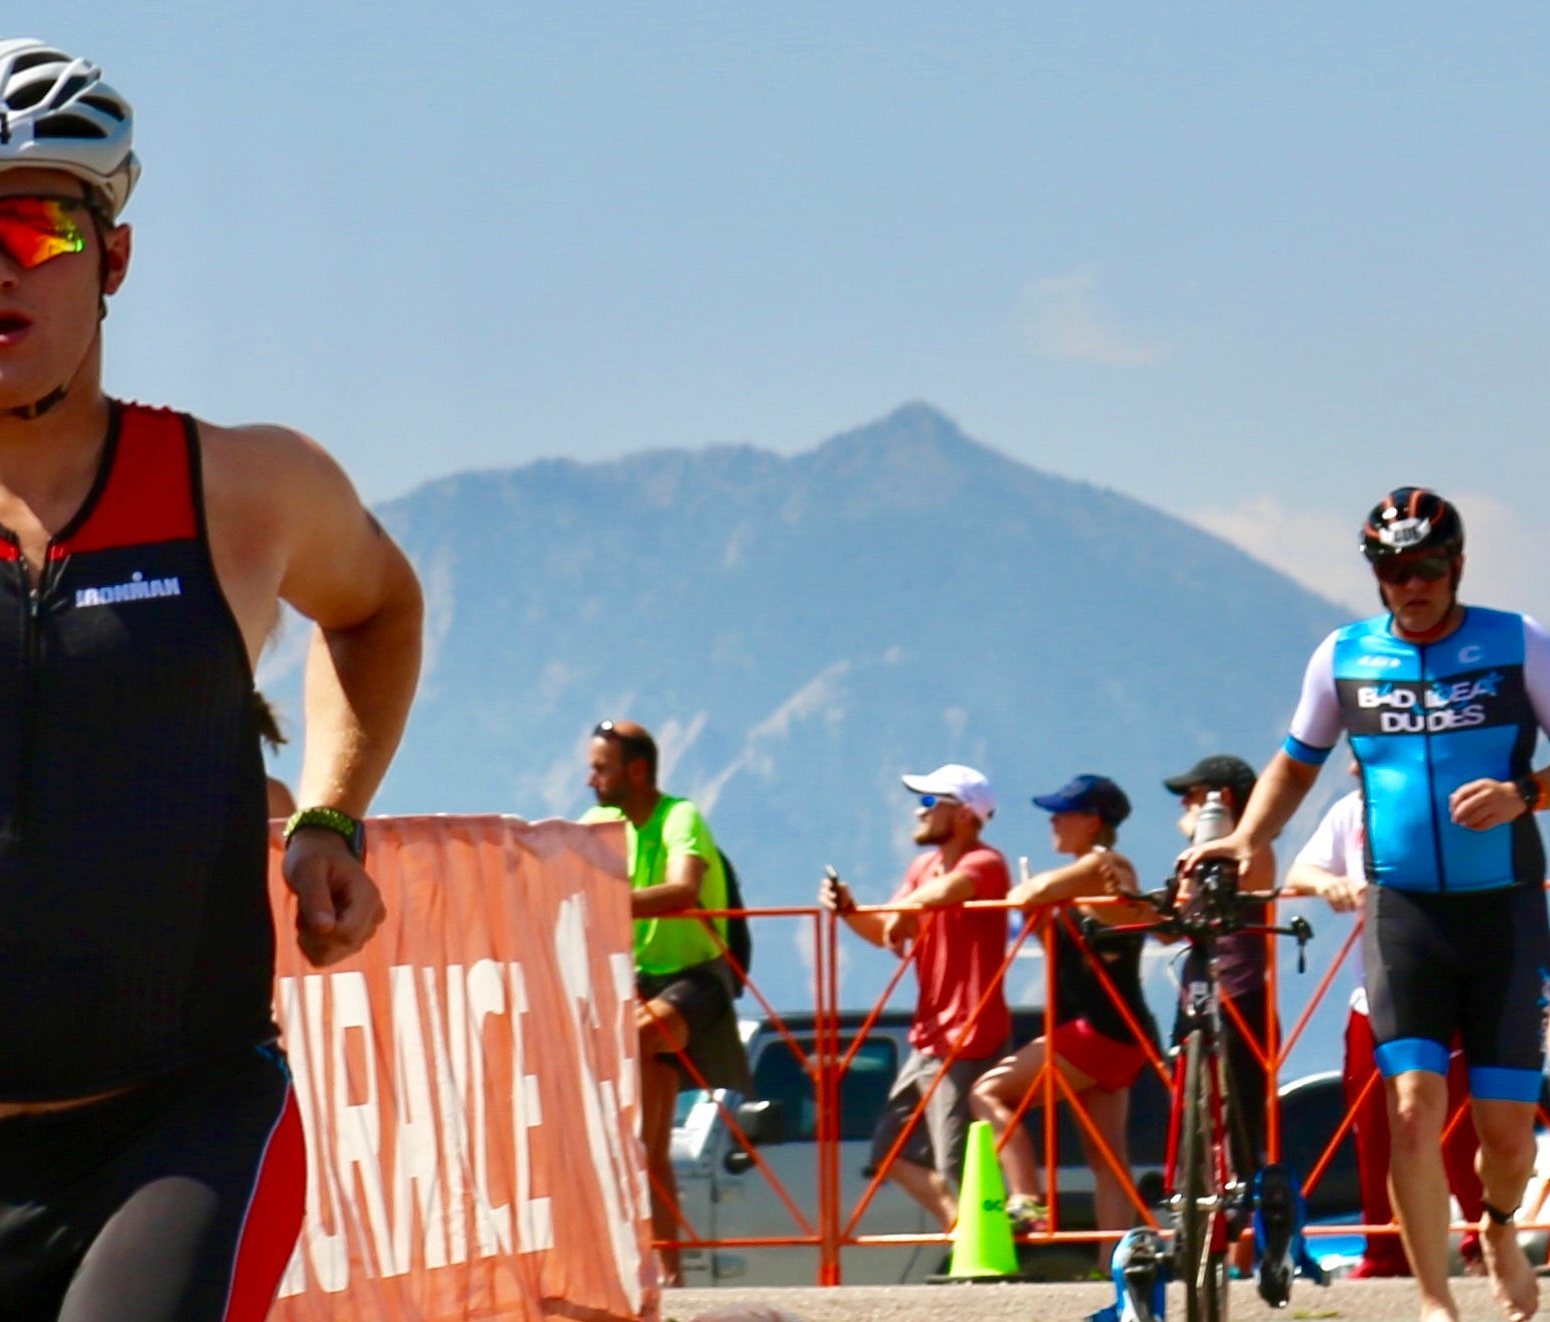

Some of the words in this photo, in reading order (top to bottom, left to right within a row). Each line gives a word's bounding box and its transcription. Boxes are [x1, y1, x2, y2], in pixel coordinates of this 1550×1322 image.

[75, 571, 180, 607] IRONMAN
[1357, 682, 1417, 709] BAD
[1380, 703, 1487, 733] DUDES
